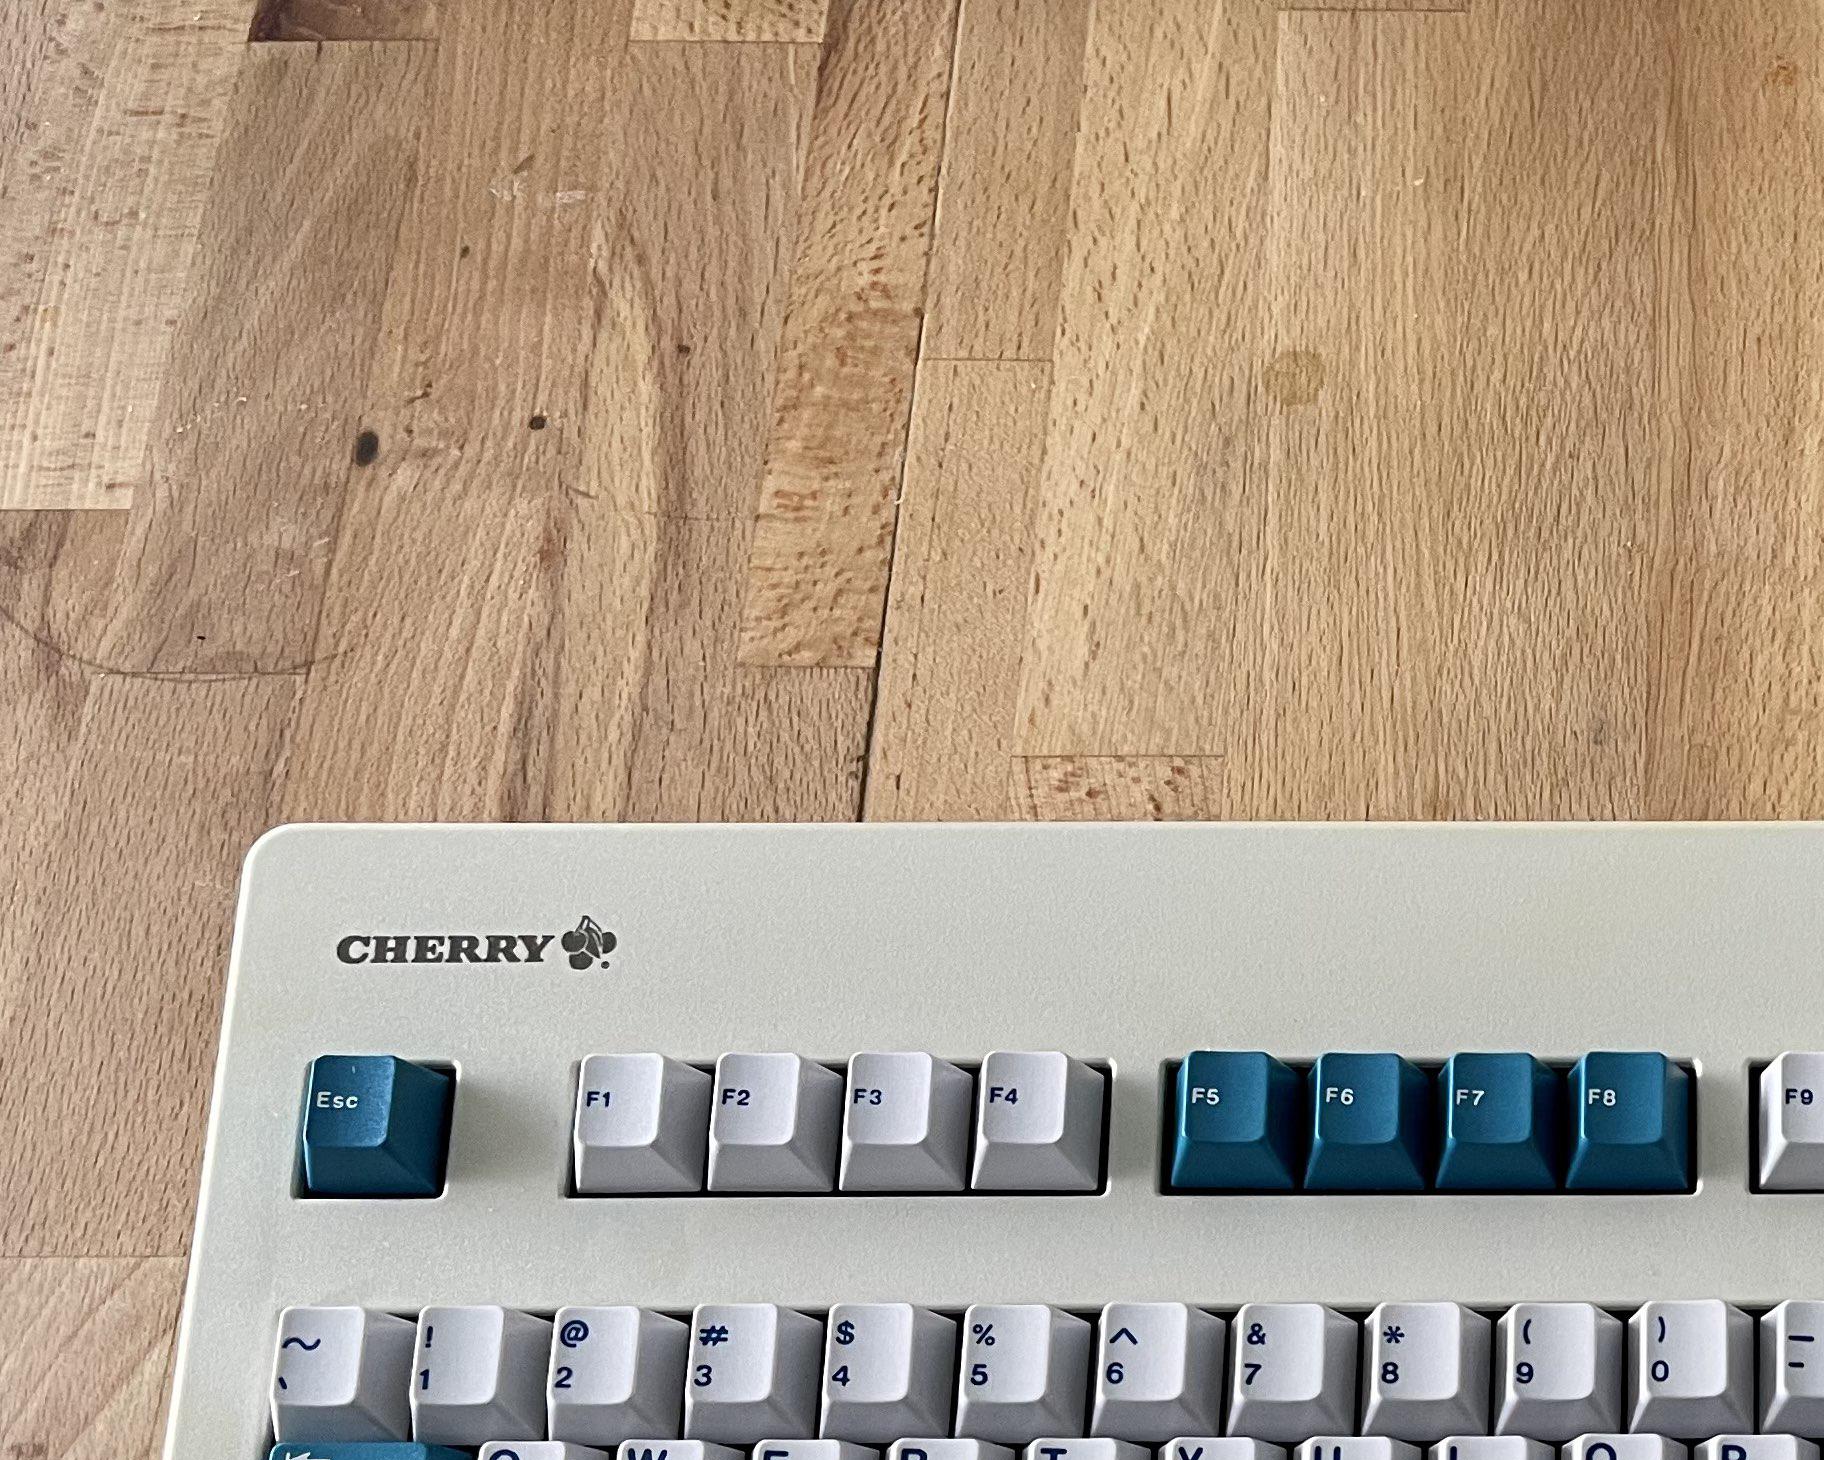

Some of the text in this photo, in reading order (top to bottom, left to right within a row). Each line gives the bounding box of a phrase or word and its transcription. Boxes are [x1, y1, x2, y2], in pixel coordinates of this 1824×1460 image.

[337, 935, 555, 964] CHERRY
[317, 1092, 357, 1108] Esc
[587, 1091, 610, 1107] F1
[722, 1089, 750, 1105] F2
[854, 1089, 881, 1105] F3
[990, 1087, 1018, 1104] F4
[1192, 1088, 1219, 1104] F5
[1326, 1088, 1353, 1104] F6
[1457, 1090, 1484, 1105] F7
[1589, 1089, 1615, 1106] F8
[1785, 1088, 1813, 1105] F9
[560, 1320, 589, 1348] @
[699, 1326, 728, 1346] #
[836, 1320, 854, 1345] $
[973, 1324, 995, 1346] %
[1110, 1328, 1138, 1345] ^
[1247, 1323, 1266, 1345] &
[282, 1337, 321, 1351] ~
[555, 1367, 573, 1388] 2
[694, 1365, 712, 1386] 3
[832, 1366, 850, 1386] 4
[971, 1364, 988, 1385] 5
[1106, 1362, 1123, 1384] 6
[1245, 1363, 1262, 1385] 7
[1382, 1362, 1399, 1384] 8
[1517, 1362, 1533, 1384] 9
[1652, 1360, 1669, 1382] 0
